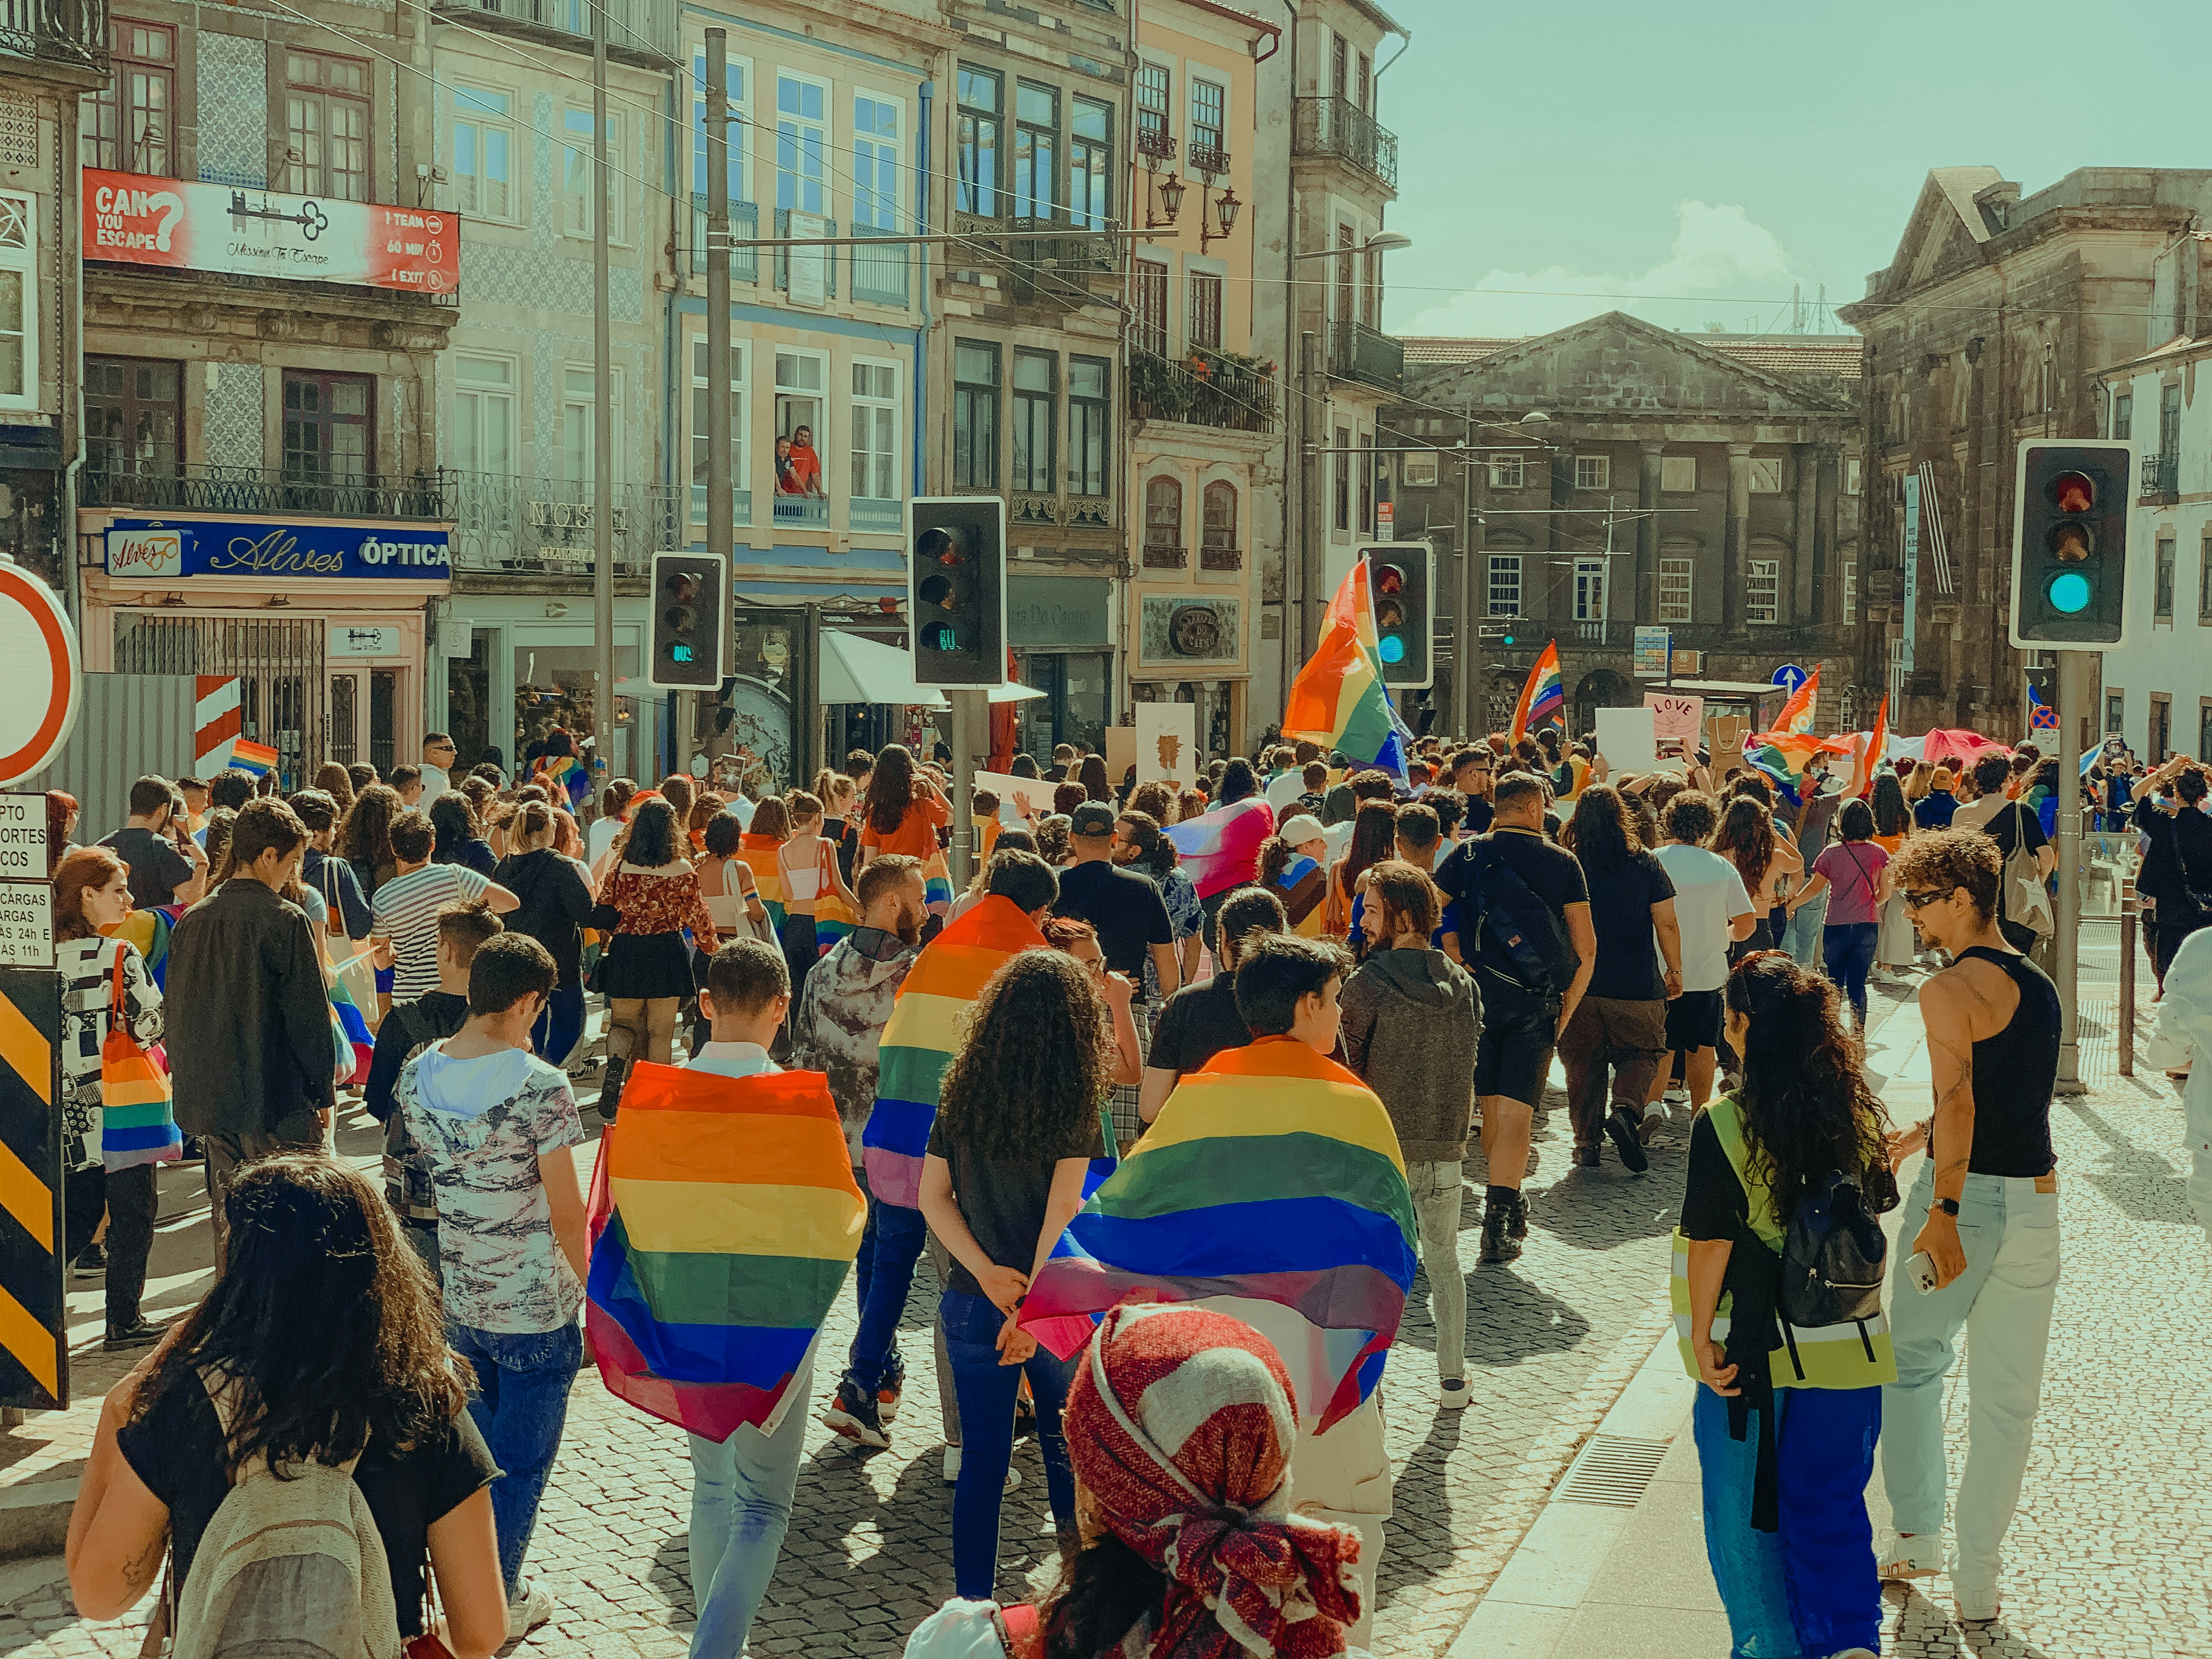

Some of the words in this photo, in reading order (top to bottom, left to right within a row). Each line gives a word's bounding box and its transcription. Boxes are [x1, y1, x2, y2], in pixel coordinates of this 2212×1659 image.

[95, 186, 148, 218] CAN
[96, 213, 122, 230] YOU
[393, 213, 425, 228] TEAM
[97, 229, 155, 250] ESCAPE
[387, 239, 402, 254] 60
[405, 242, 425, 256] MIN
[227, 242, 270, 258] Mission
[272, 246, 287, 261] To
[288, 248, 329, 267] Escape
[399, 270, 425, 284] EXIT
[529, 501, 629, 531] NOSI
[112, 539, 156, 571] Alves
[210, 529, 345, 572] Alves
[1654, 699, 1693, 715] LOVE
[0, 805, 24, 821] PTO
[1, 828, 46, 844] ORTES
[1, 851, 28, 866] COS
[1, 893, 46, 906] CARGAS
[18, 928, 37, 939] 24h
[43, 928, 50, 940] E
[1, 941, 15, 956] ÀS
[22, 945, 39, 957] 11h
